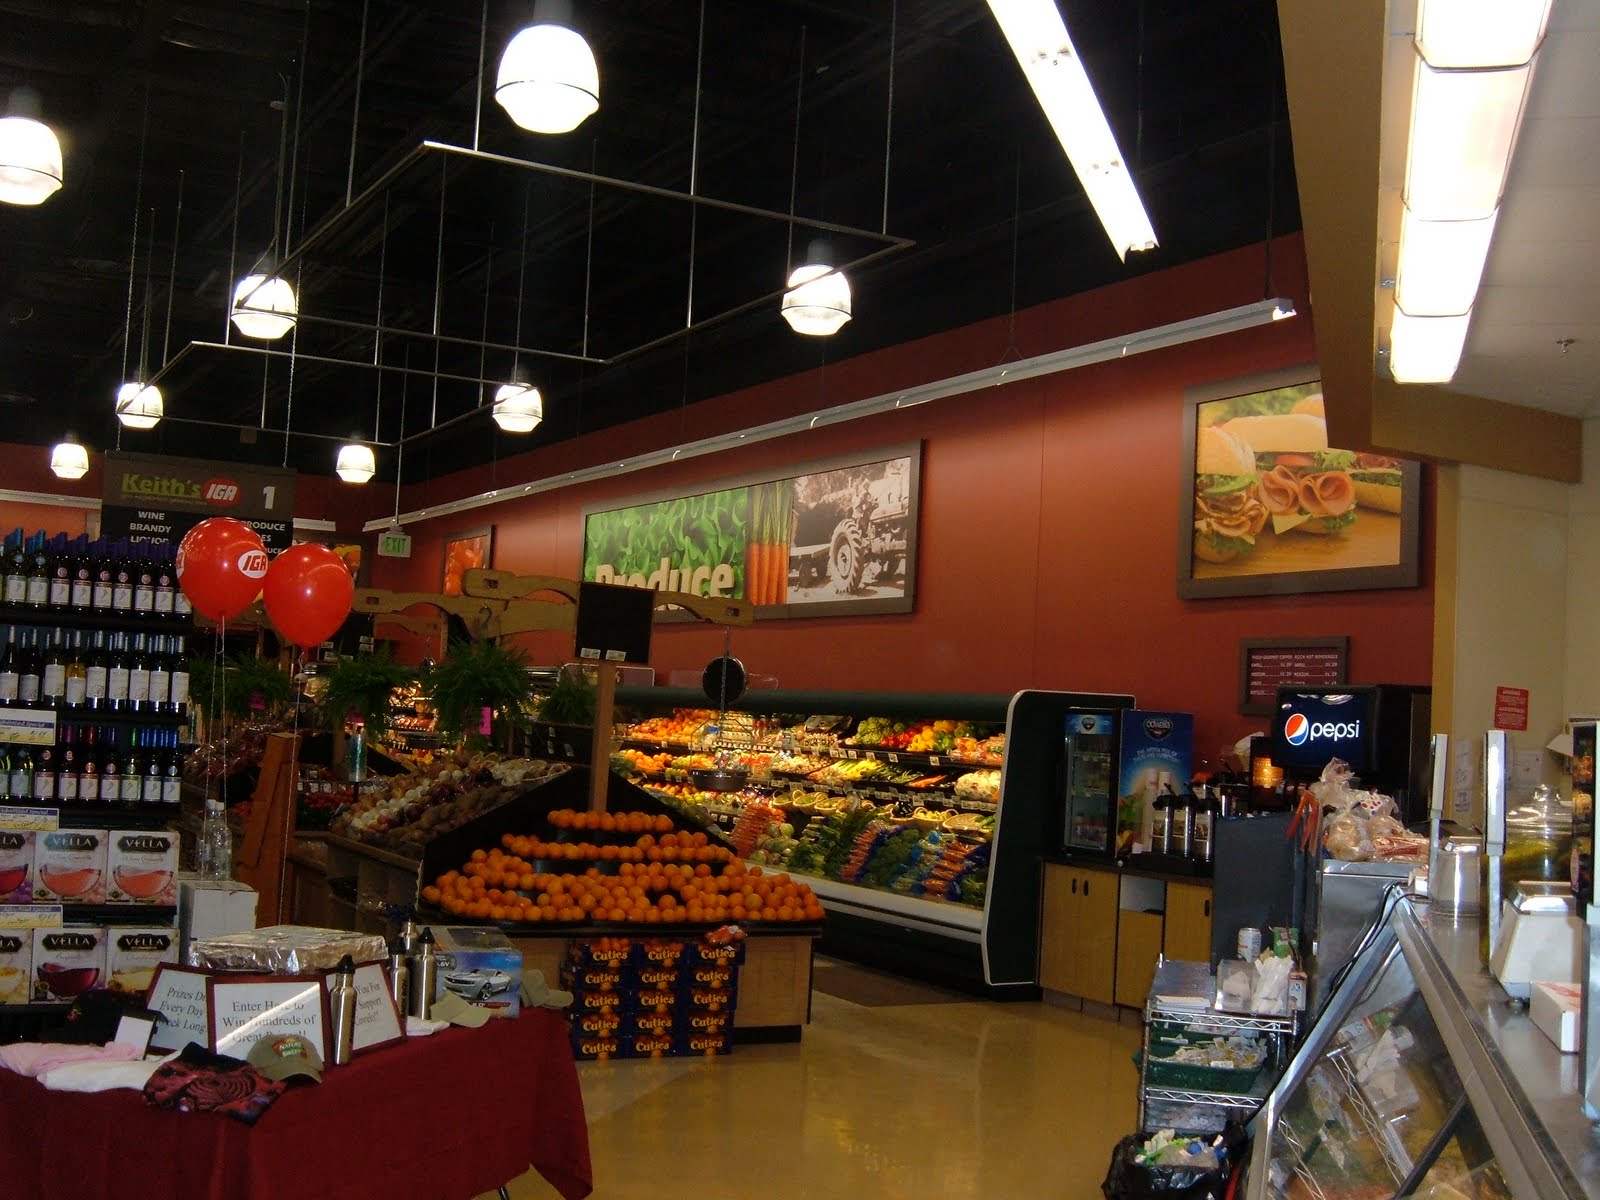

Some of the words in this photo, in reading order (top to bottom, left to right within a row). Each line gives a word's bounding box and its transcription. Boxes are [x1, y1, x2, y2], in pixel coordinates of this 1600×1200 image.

[121, 473, 201, 499] Keith's
[205, 483, 238, 501] IGA
[262, 486, 276, 509] 1
[138, 510, 165, 520] WINE
[129, 523, 171, 533] BRANDY
[385, 536, 407, 552] EXIT
[242, 555, 266, 572] IGA
[1310, 720, 1360, 742] pepsi
[52, 838, 92, 847] VELLA
[125, 839, 164, 848] VELLA
[50, 937, 90, 946] VELLA
[125, 937, 164, 946] VELLA
[592, 950, 628, 961] Cuties
[648, 949, 681, 961] Cuties
[700, 948, 735, 959] Cuties
[585, 972, 620, 984] Cuties
[641, 971, 675, 983] Cuties
[695, 970, 729, 982] Cuties
[167, 987, 194, 999] Prizes
[368, 982, 380, 992] For
[358, 998, 382, 1010] Support
[584, 995, 619, 1007] Cuties
[640, 994, 675, 1006] Cuties
[693, 993, 728, 1004] Cuties
[159, 1000, 185, 1016] Every
[187, 1005, 203, 1018] Day
[232, 1001, 262, 1012] Enter
[265, 1000, 292, 1011] Hee
[294, 1002, 304, 1010] to
[223, 1016, 245, 1027] Win
[304, 1014, 316, 1025] of
[583, 1019, 618, 1031] Cuties
[638, 1018, 672, 1029] Cuties
[691, 1016, 725, 1027] Cuties
[581, 1042, 617, 1054] Cuties
[636, 1040, 670, 1052] Cuties
[690, 1039, 723, 1050] Cuties
